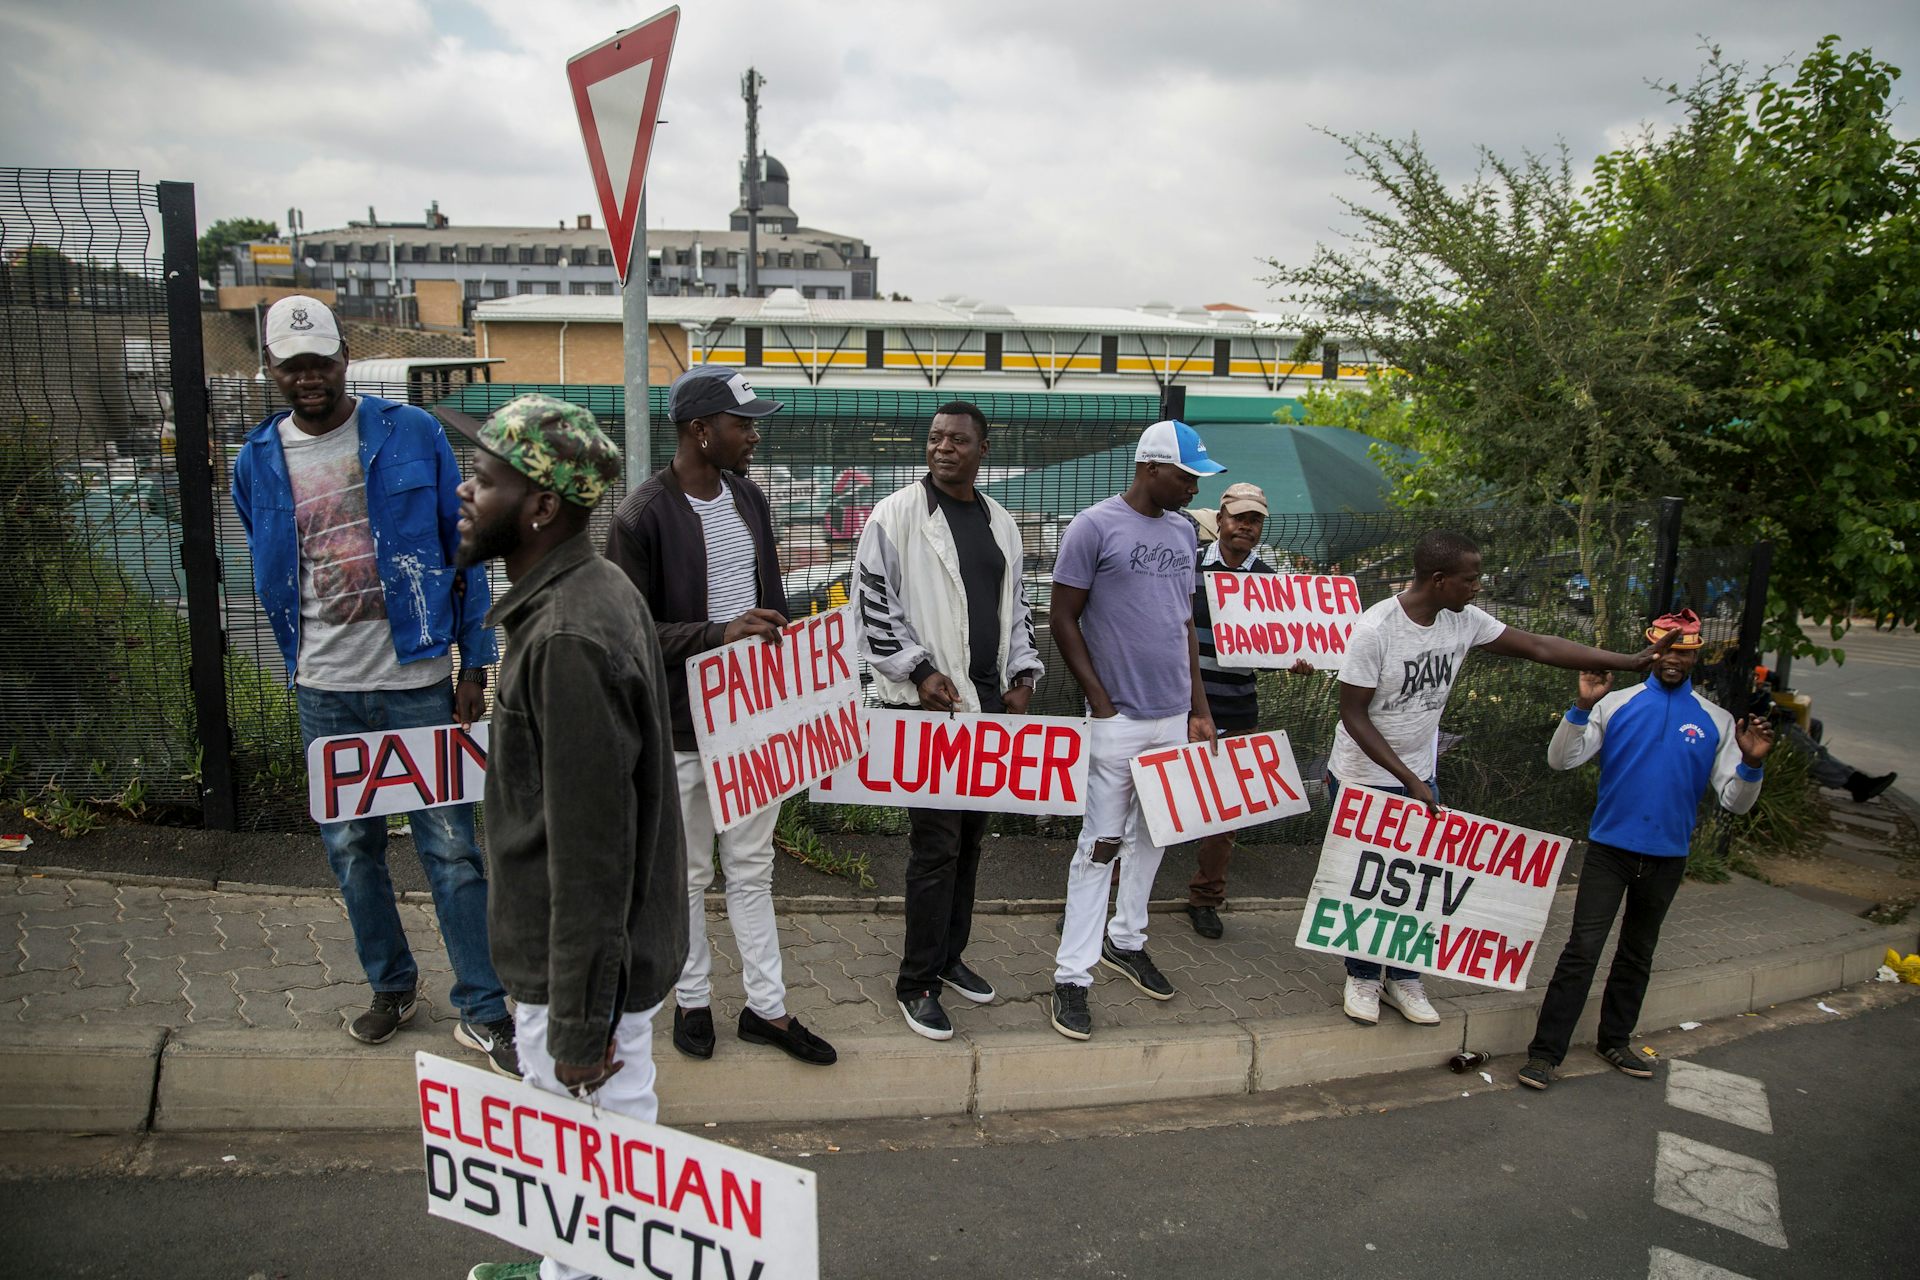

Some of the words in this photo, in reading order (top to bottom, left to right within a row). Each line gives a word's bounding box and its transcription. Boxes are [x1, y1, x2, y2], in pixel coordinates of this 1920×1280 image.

[1214, 573, 1361, 615] PAINTER
[699, 611, 851, 735] PAINTER
[1400, 651, 1455, 695] RAW
[712, 700, 863, 825] HANDYMAN
[820, 719, 1082, 802] LUMBER
[1138, 733, 1300, 833] TILER
[1332, 787, 1561, 888] ELECTRICIAN
[1350, 850, 1475, 916] DSTV
[419, 1078, 762, 1239] ELECTRICIAN
